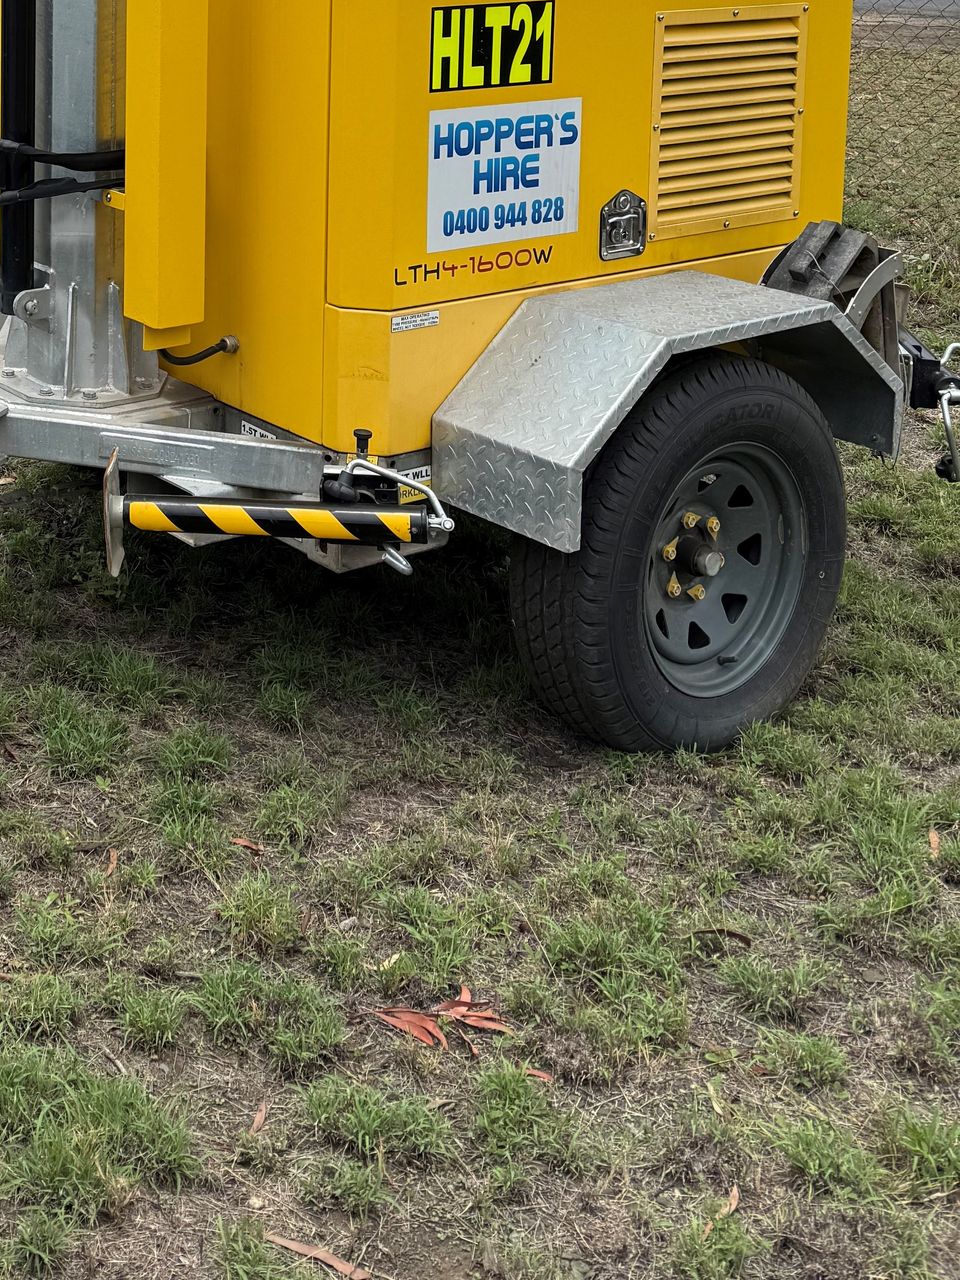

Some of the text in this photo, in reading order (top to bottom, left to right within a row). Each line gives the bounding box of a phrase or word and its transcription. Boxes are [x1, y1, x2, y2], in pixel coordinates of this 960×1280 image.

[432, 1, 553, 90] HLT21
[433, 111, 579, 160] HOPPER'S
[473, 153, 540, 195] HIRE
[443, 197, 565, 237] 0400 944 828
[394, 245, 553, 287] LTH4-1600W
[242, 424, 258, 437] 1.5T
[412, 468, 431, 480] WLL
